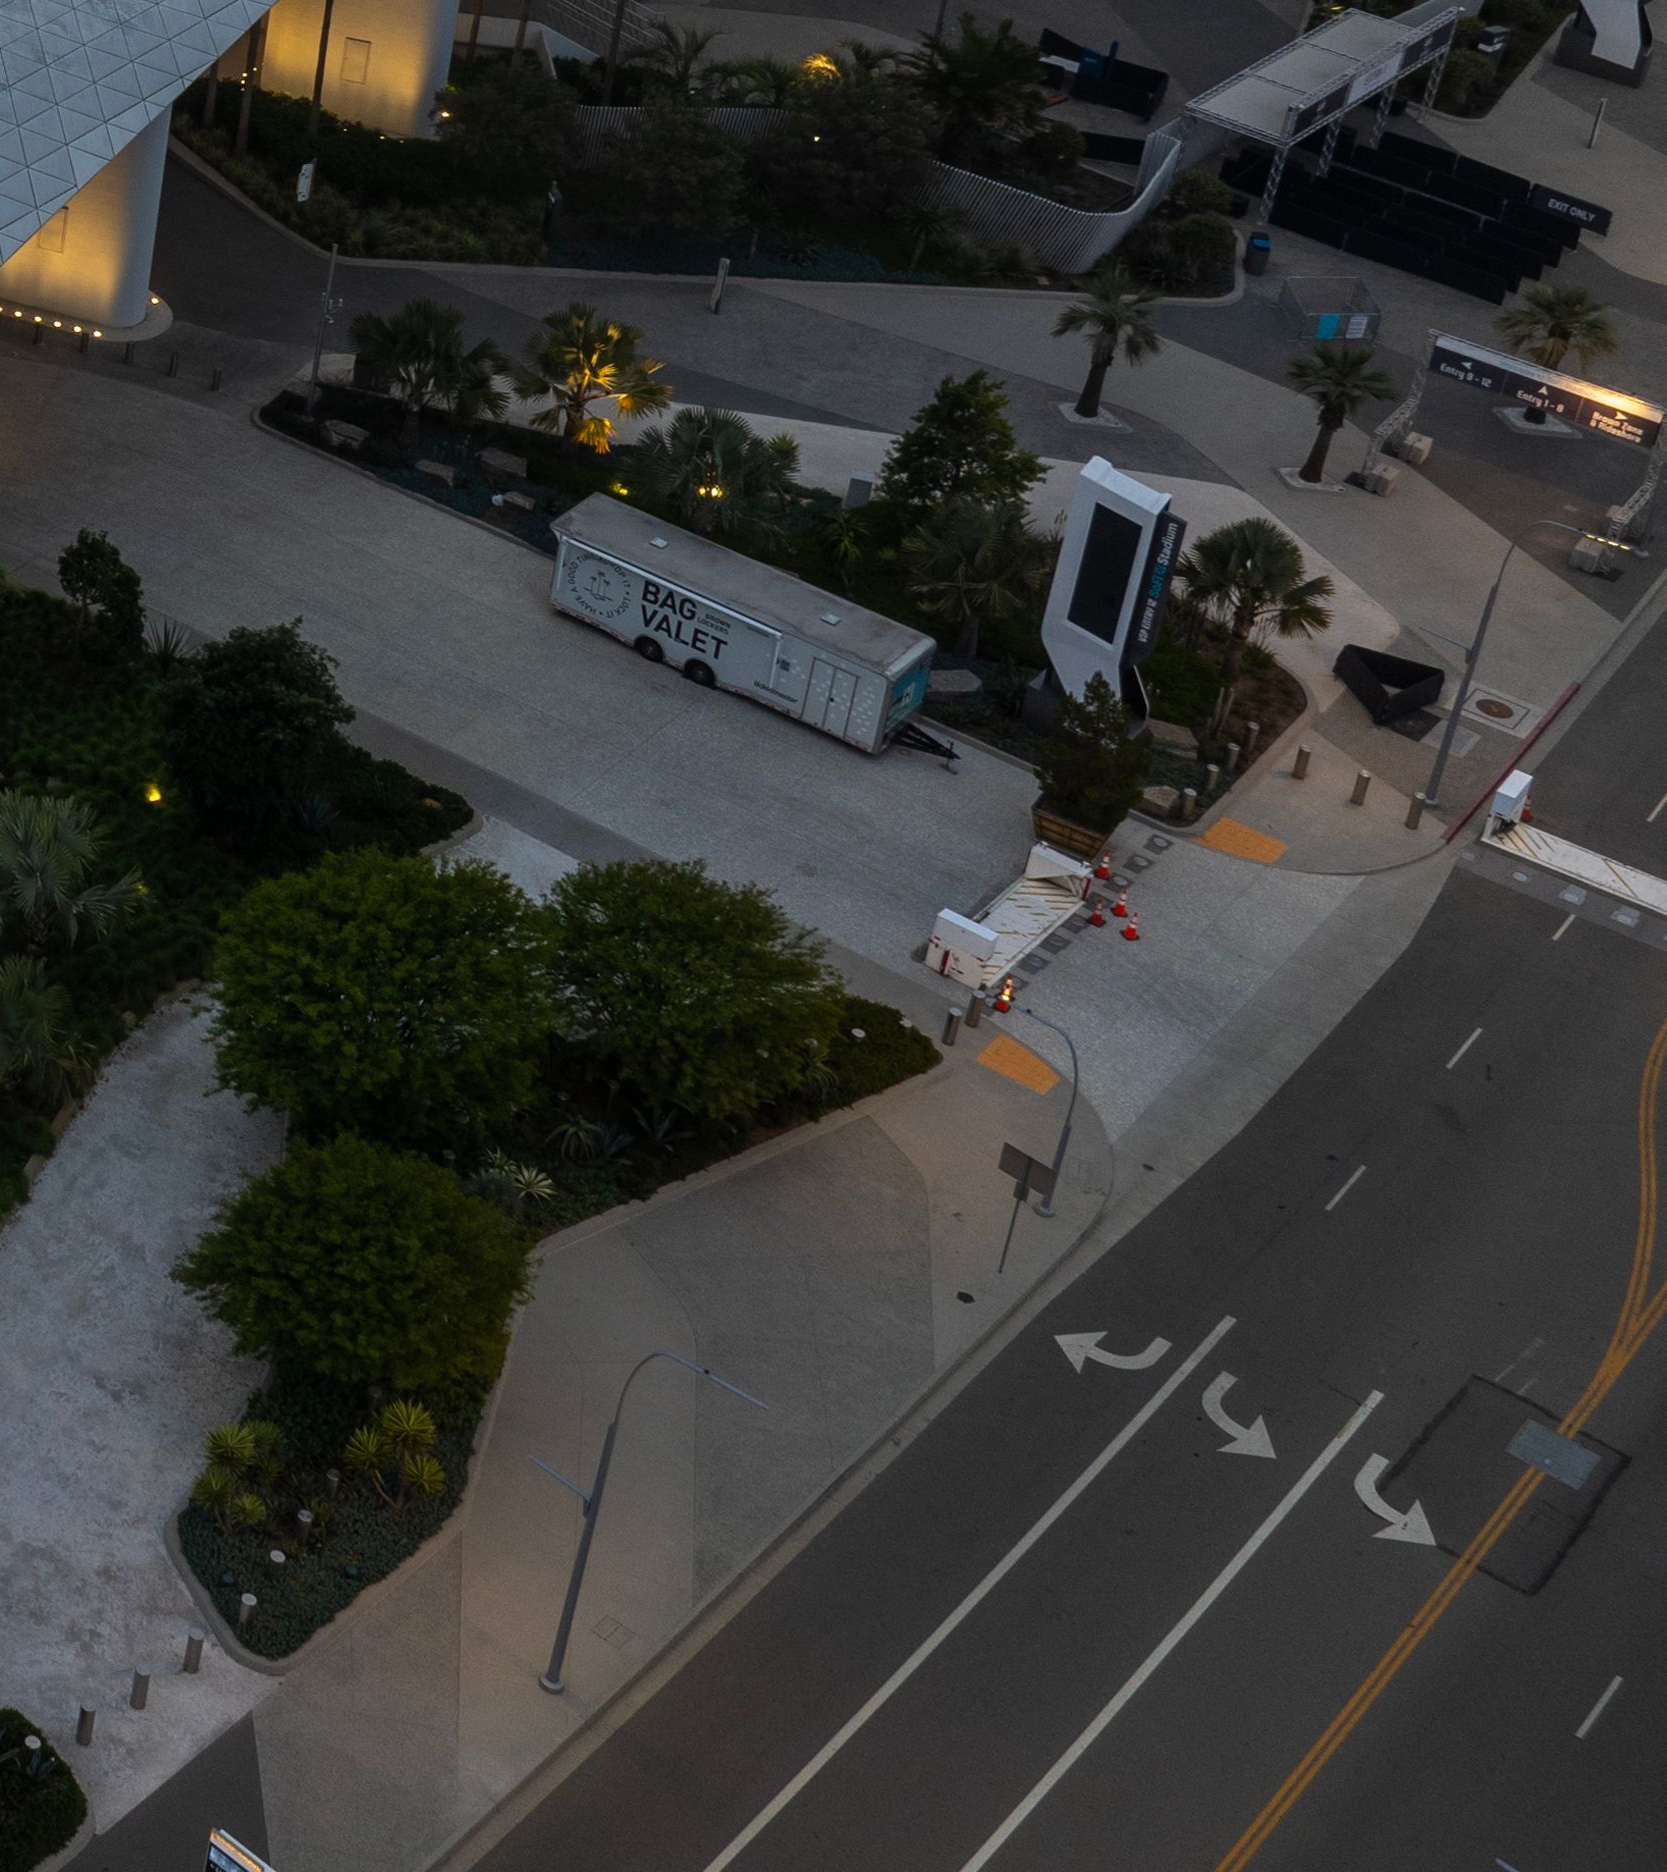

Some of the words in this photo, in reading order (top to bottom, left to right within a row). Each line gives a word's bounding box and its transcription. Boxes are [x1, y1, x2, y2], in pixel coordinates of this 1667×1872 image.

[1547, 198, 1570, 214] EXIT
[1569, 206, 1596, 222] ONLY
[1439, 362, 1466, 382] Entry
[1481, 377, 1492, 388] 12
[1516, 389, 1542, 408] Entry
[1156, 522, 1179, 566] Stadium
[568, 561, 579, 585] GOOD
[1148, 574, 1165, 599] SoFi
[613, 597, 631, 616] LOCK
[642, 580, 698, 621] BAG
[641, 603, 728, 660] VALET
[705, 613, 731, 629] BROWN
